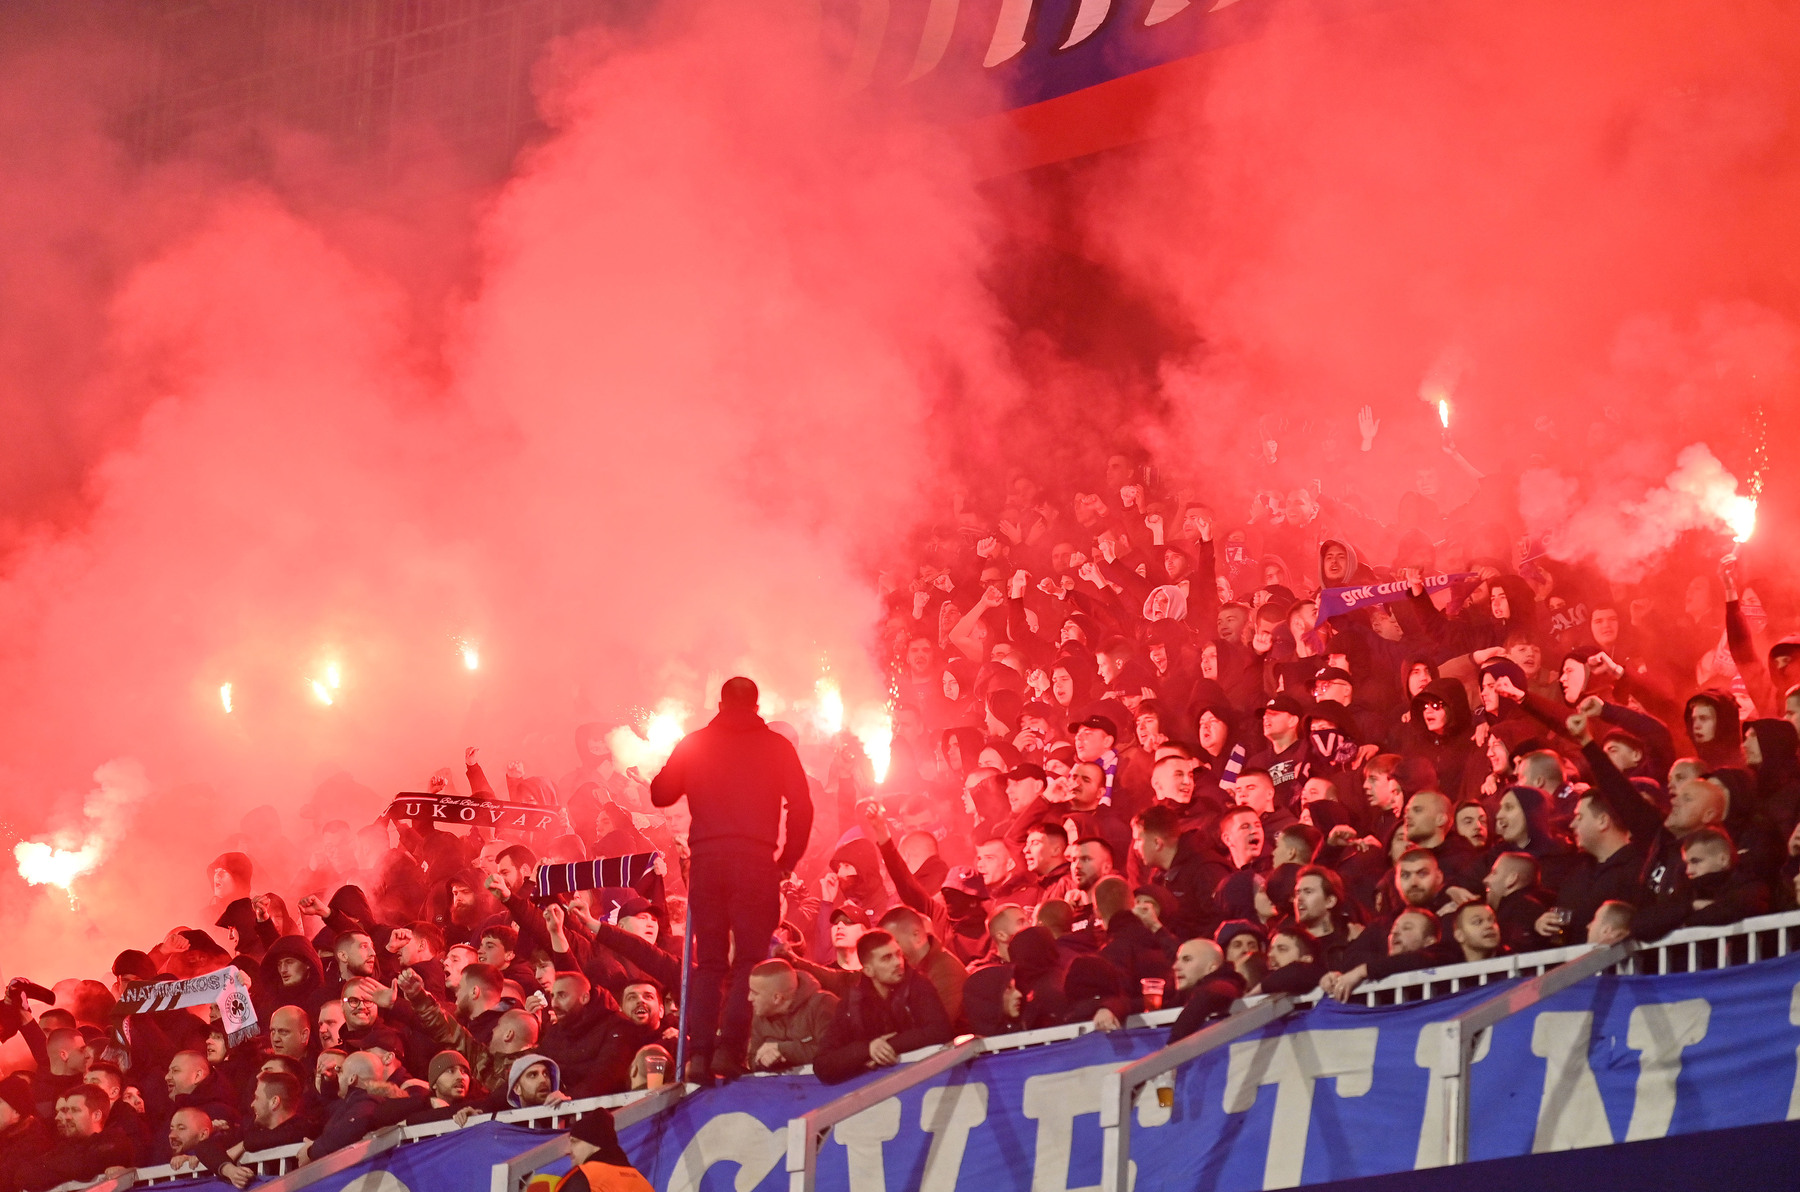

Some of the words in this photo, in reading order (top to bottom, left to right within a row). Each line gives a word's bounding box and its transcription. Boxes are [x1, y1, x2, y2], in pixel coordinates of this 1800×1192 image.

[1341, 586, 1374, 607] gnk
[1377, 574, 1449, 594] dinmo
[405, 802, 552, 831] UKOVAR
[120, 975, 221, 1003] ANATHINAIKOS
